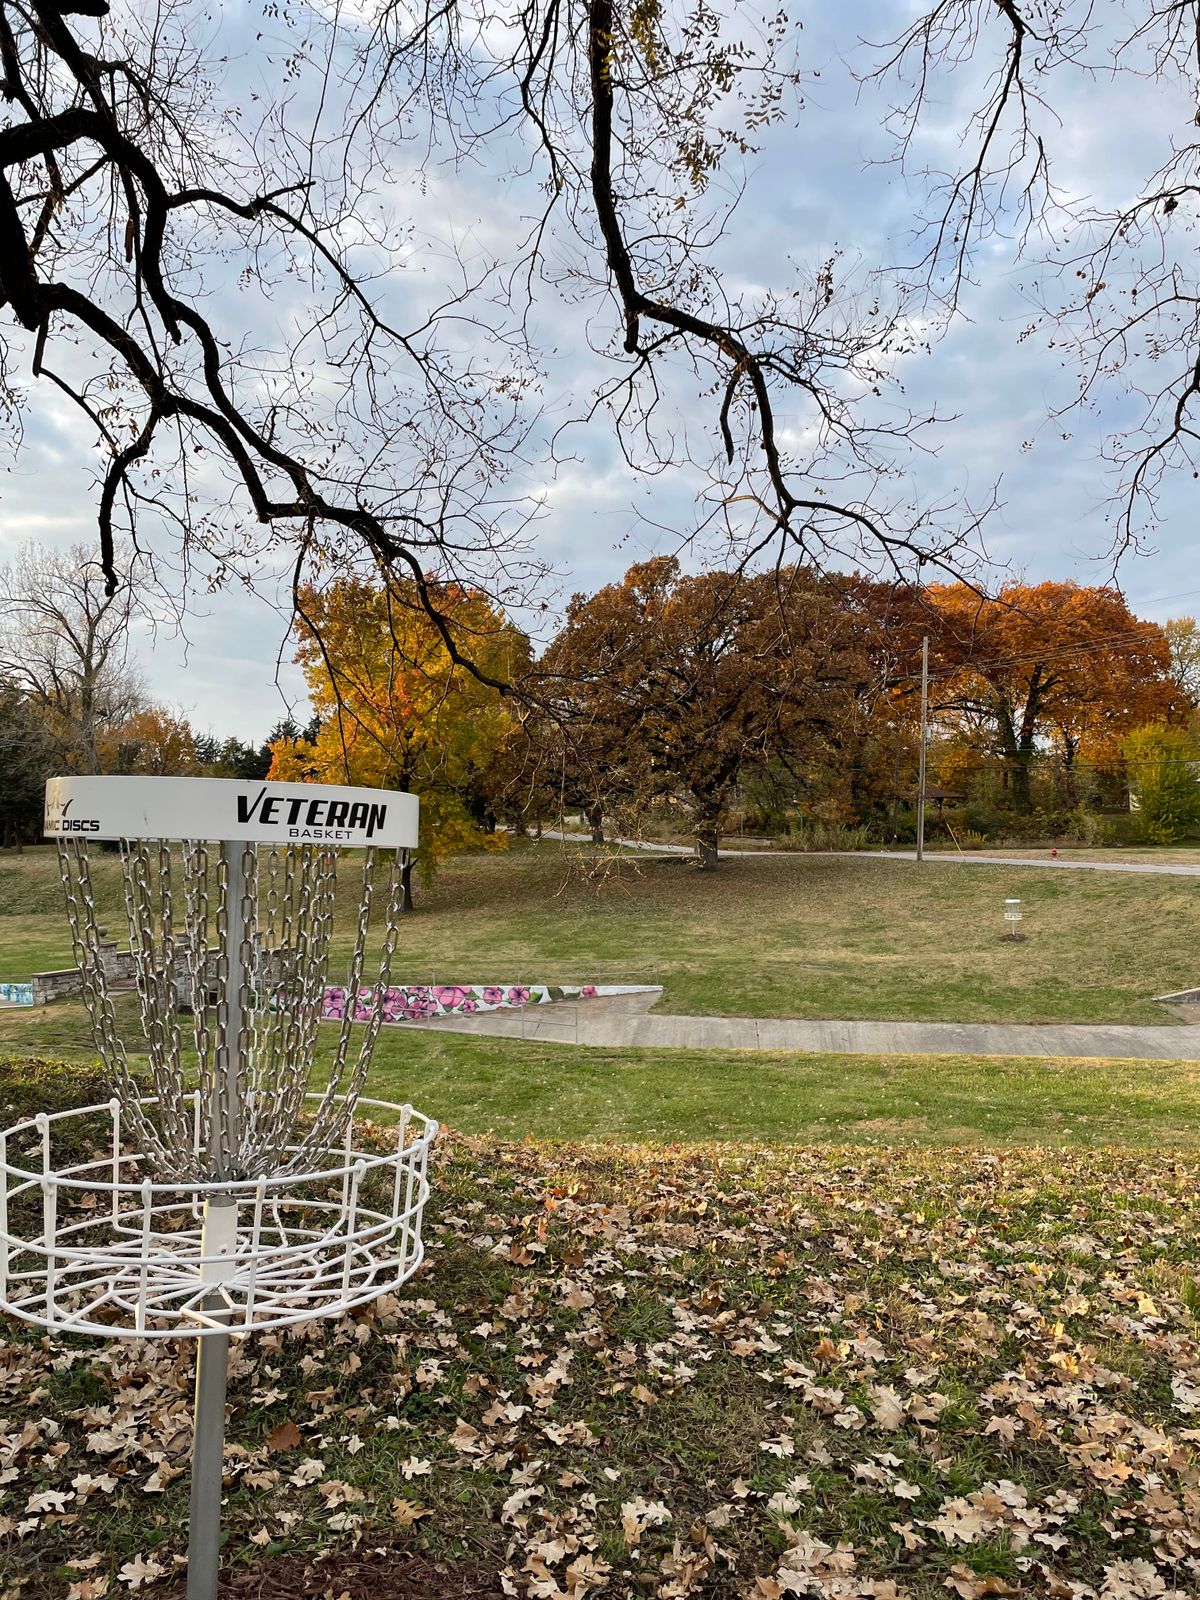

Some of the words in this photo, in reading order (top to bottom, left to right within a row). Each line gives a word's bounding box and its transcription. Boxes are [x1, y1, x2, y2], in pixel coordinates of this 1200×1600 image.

[237, 787, 387, 838] VETERAN
[62, 820, 100, 831] DISCS
[289, 828, 353, 839] BASKET
